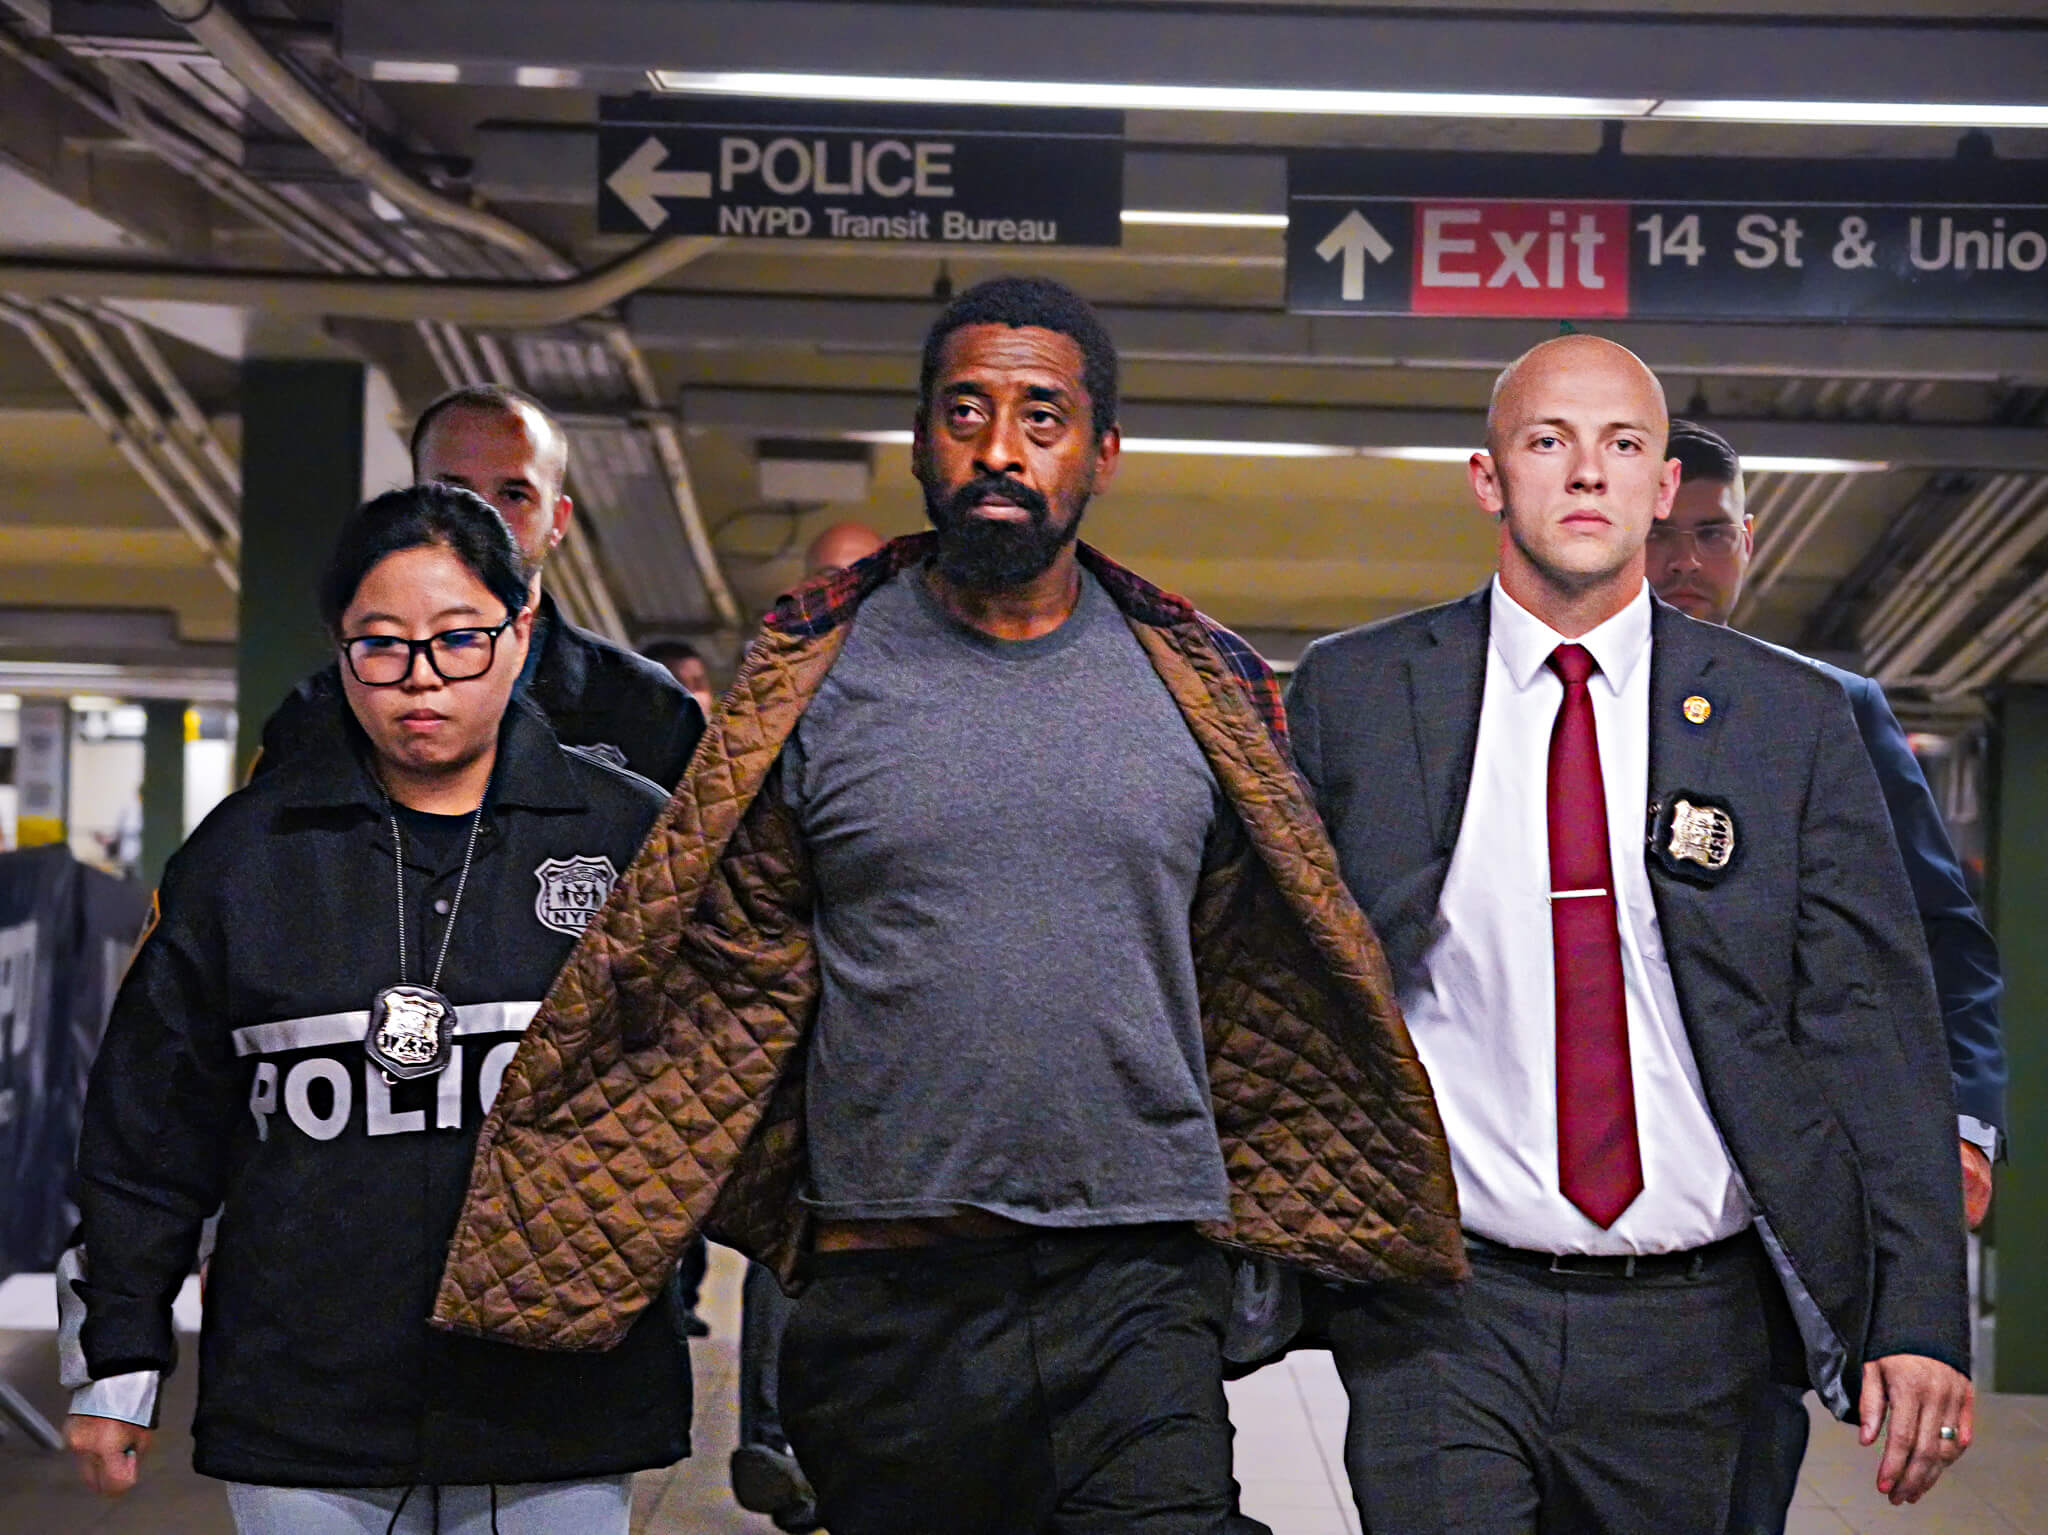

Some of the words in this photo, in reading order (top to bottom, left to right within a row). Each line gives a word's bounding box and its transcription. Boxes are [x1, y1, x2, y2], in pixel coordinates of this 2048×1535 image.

[721, 138, 955, 197] POLICE
[718, 206, 811, 237] NYPD
[826, 208, 929, 239] Transit
[943, 211, 1057, 242] Bureau
[1421, 209, 1605, 289] Exit
[1637, 214, 1706, 266] 14
[1734, 214, 1803, 269] St
[1831, 216, 1877, 270] &
[1909, 217, 2048, 271] Unio
